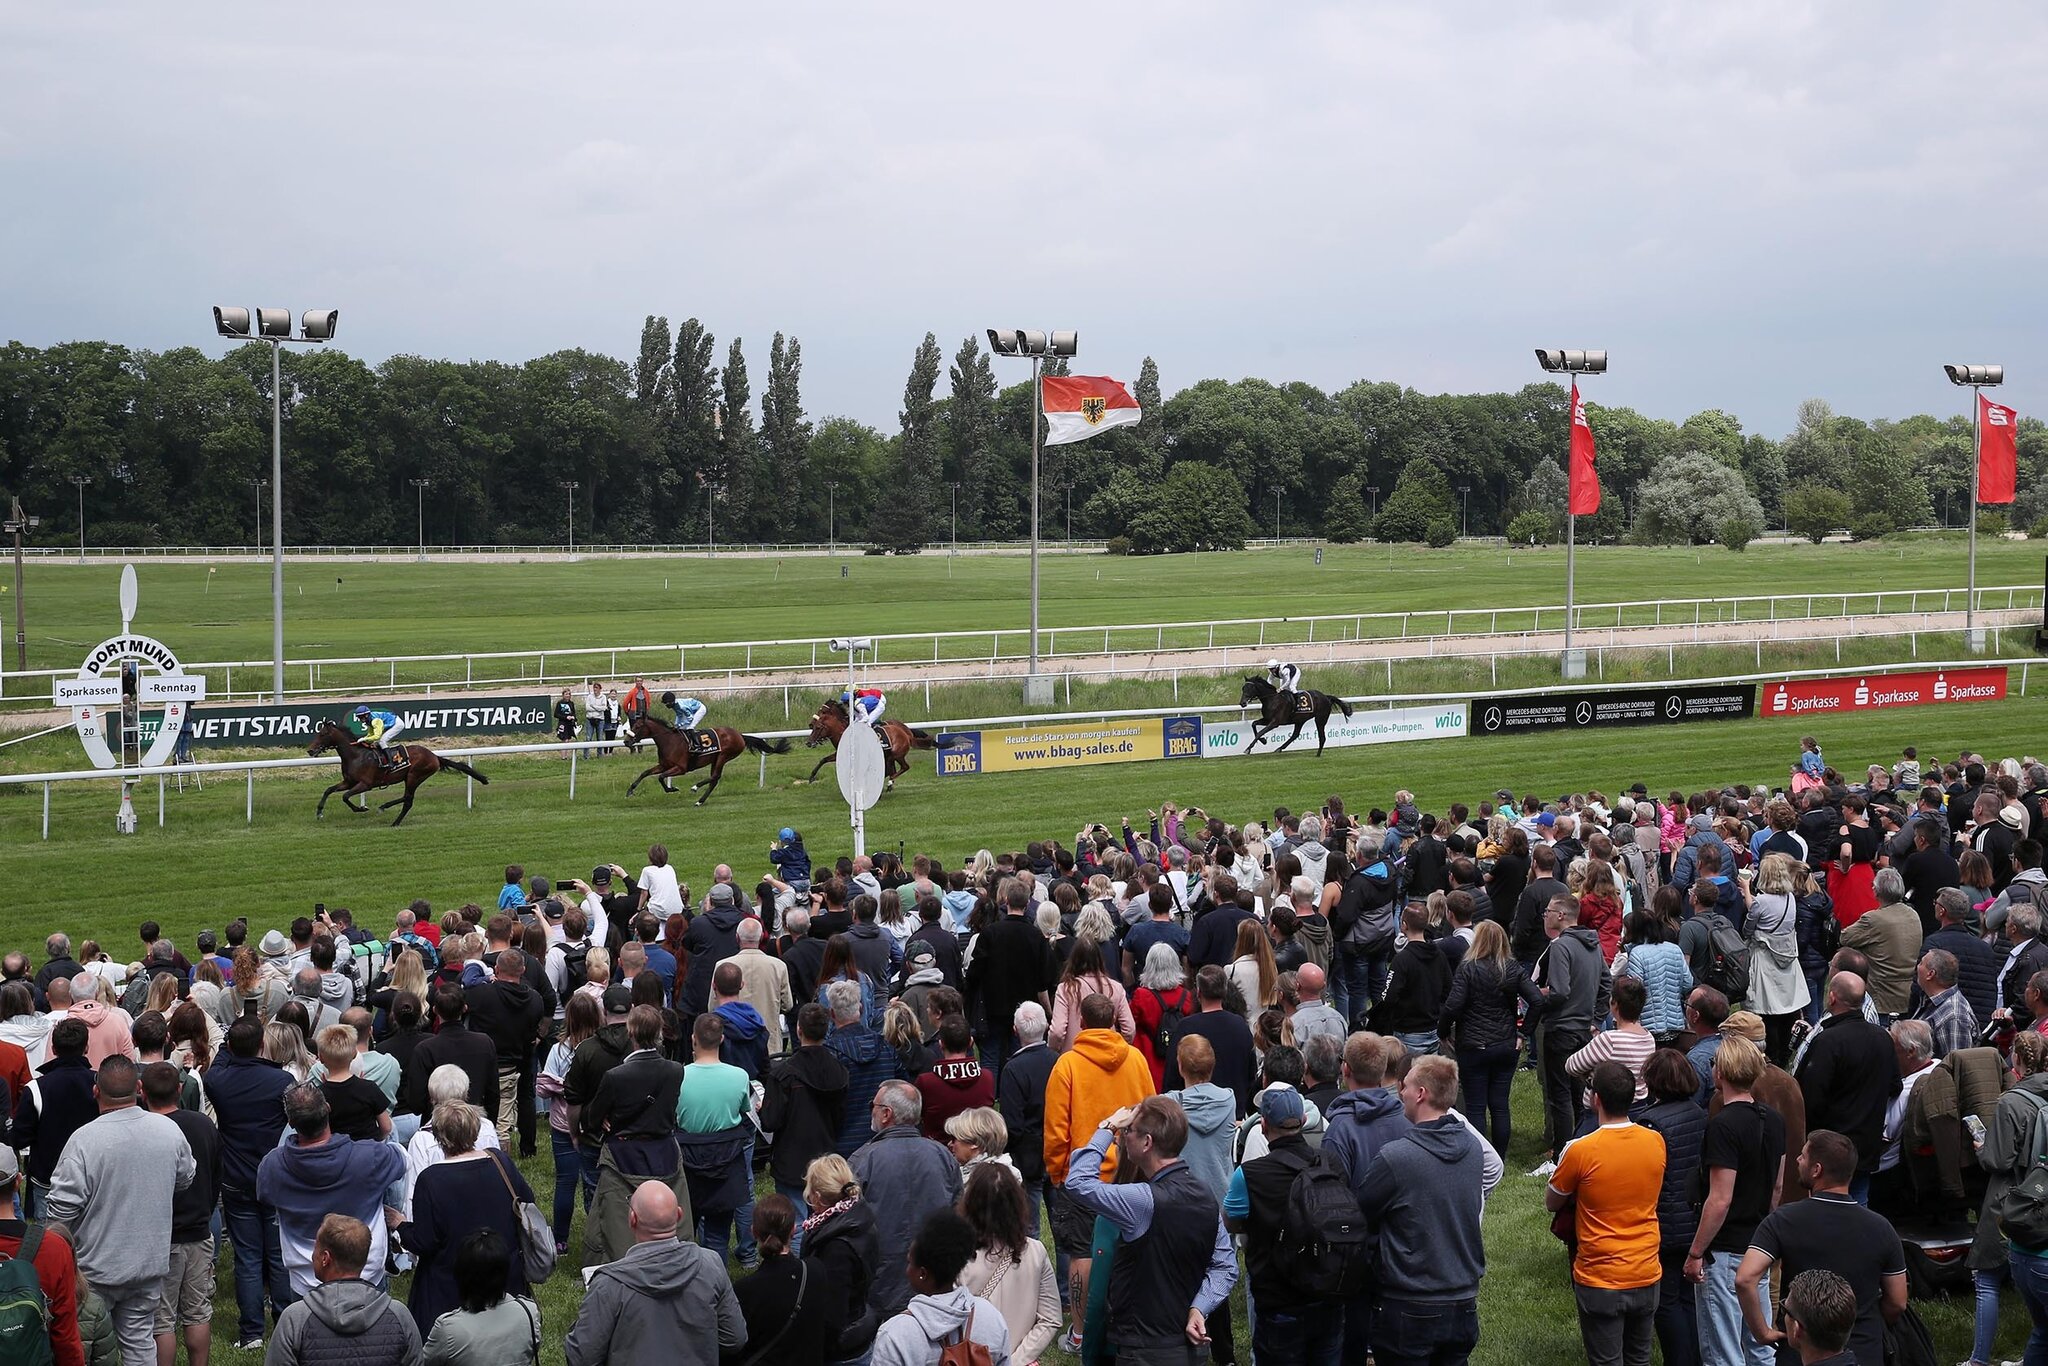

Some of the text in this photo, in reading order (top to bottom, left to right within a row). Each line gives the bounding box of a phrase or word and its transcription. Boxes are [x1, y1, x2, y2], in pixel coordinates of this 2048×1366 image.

[87, 639, 175, 675] DORTMUND
[59, 686, 118, 698] Sparkassen
[149, 683, 197, 695] -Renntag
[1950, 684, 1996, 701] Sparkasse
[1299, 695, 1308, 707] 3
[1686, 695, 1743, 706] MERCEDES-BENZ DORTMUND
[1790, 696, 1840, 712] Sparkasse
[1872, 690, 1919, 704] Sparkasse
[1596, 701, 1656, 711] MERCEDES-BENZ DORTMUND
[1685, 706, 1710, 715] DORTMUND
[404, 706, 546, 729] WETTSTAR.de
[1435, 711, 1462, 728] wilo
[1596, 712, 1621, 720] DORTMUND
[83, 728, 95, 736] 20
[167, 722, 178, 731] 22
[1270, 733, 1286, 742] den
[1327, 729, 1339, 738] die
[1340, 727, 1370, 739] Region:
[1371, 723, 1425, 734] Wilo-Pumpen.
[700, 733, 713, 748] 5
[1005, 726, 1142, 744] Heute die Stars von morgen kaufen!
[1208, 729, 1239, 748] wilo
[1014, 740, 1134, 760] www.bbag-sales.de
[1168, 737, 1198, 755] BBAG
[392, 750, 404, 764] 4
[944, 753, 976, 773] BBAG
